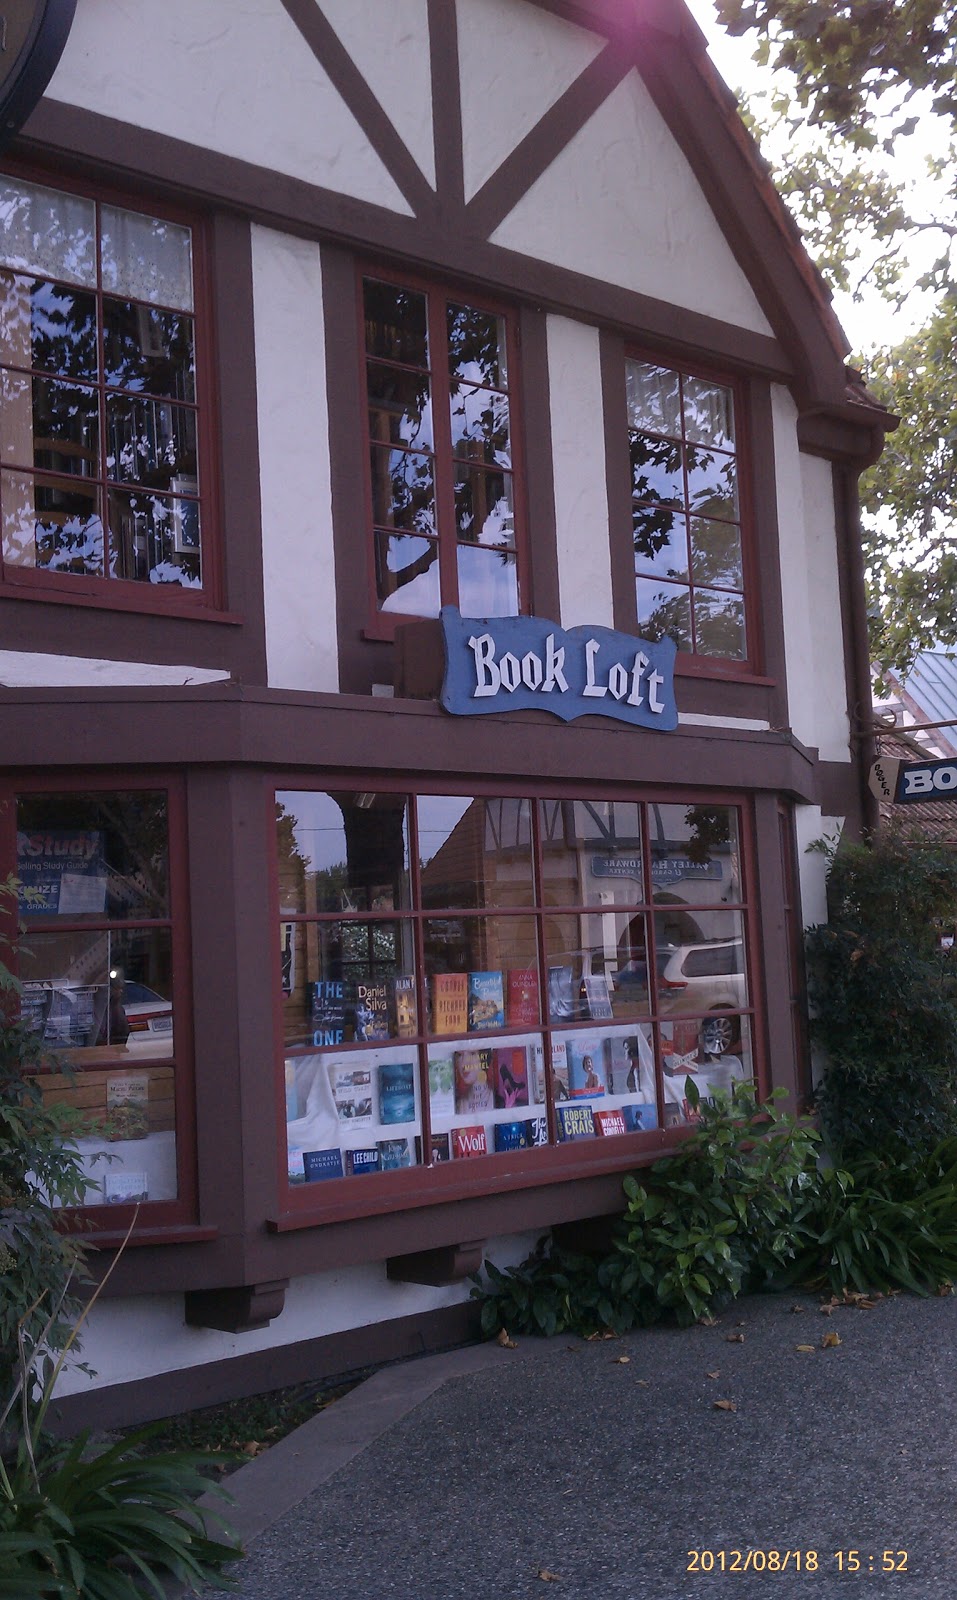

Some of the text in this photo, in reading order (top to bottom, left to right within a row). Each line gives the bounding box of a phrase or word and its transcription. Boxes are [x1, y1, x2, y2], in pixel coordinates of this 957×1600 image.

[468, 633, 665, 713] Book Loft
[43, 862, 65, 871] Study
[66, 861, 89, 870] Guide
[315, 981, 343, 998] THE
[358, 985, 386, 998] Daniel
[365, 998, 387, 1011] Silva
[313, 1029, 343, 1046] ONE
[563, 1109, 592, 1121] ROBERT
[564, 1119, 595, 1135] CRAIS
[601, 1117, 624, 1128] MICHAEL
[458, 1133, 485, 1153] Wolf
[311, 1155, 338, 1163] MICHAEL
[353, 1151, 379, 1165] LEE CHILD
